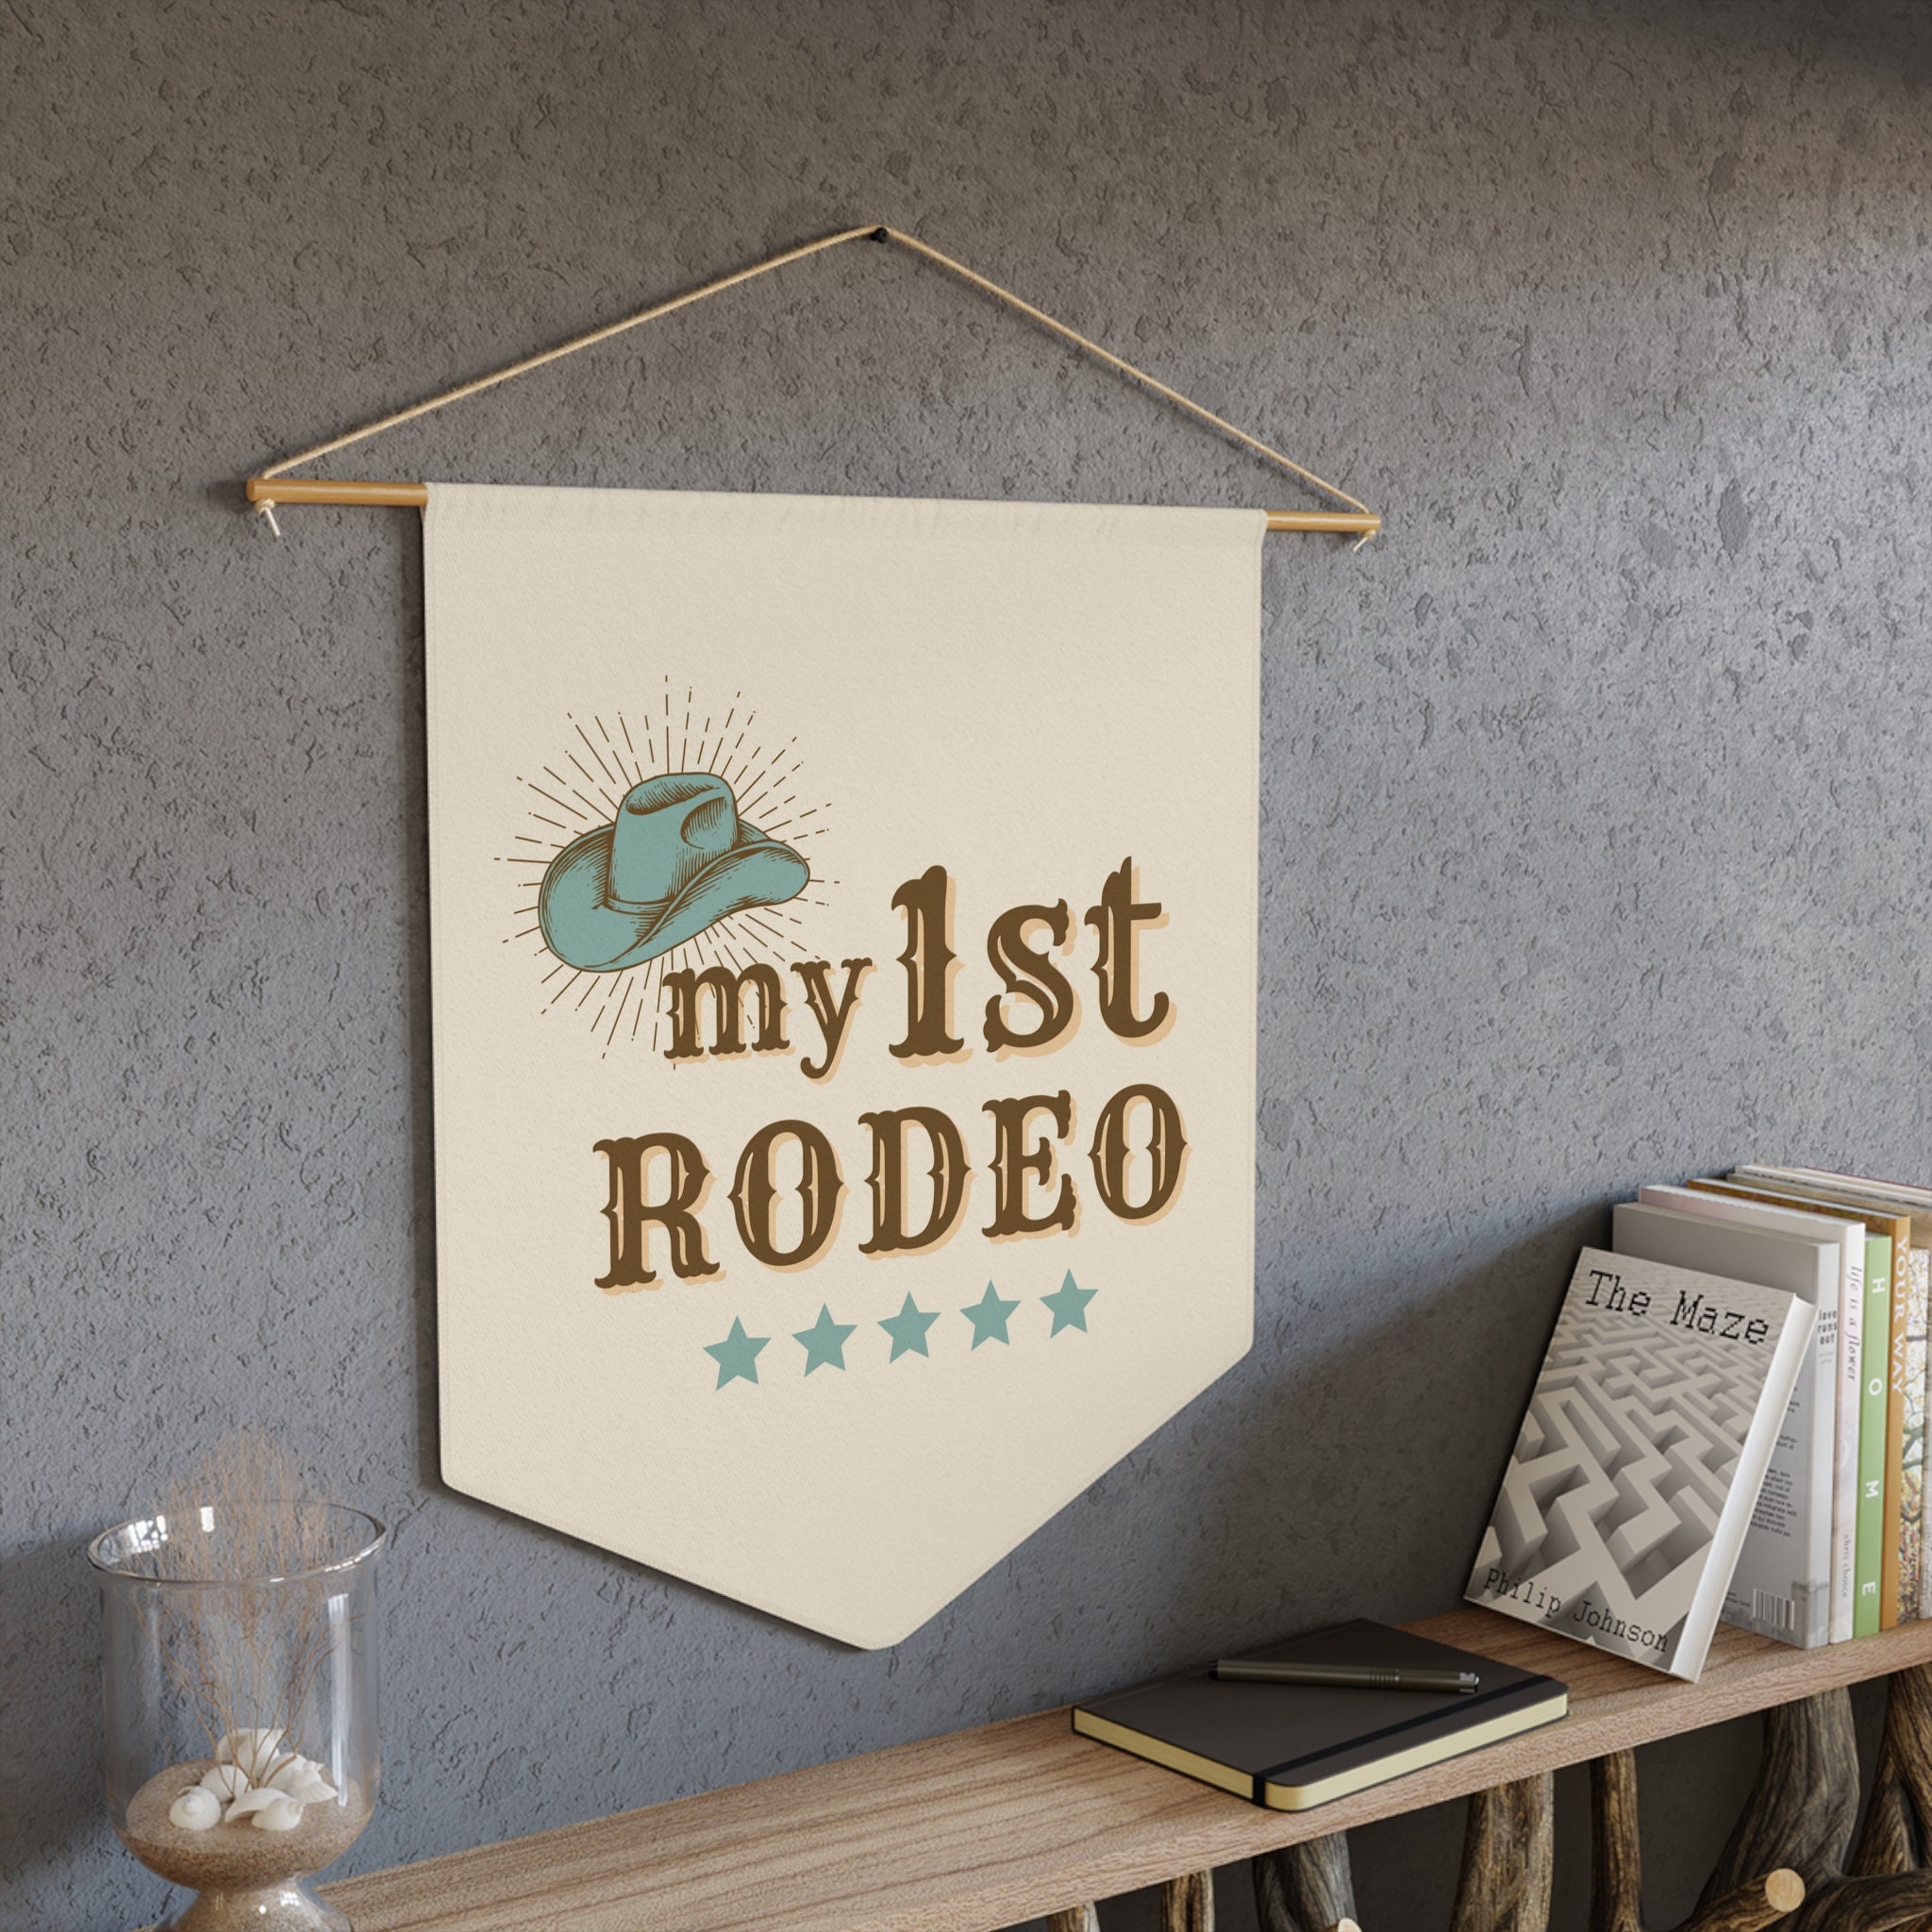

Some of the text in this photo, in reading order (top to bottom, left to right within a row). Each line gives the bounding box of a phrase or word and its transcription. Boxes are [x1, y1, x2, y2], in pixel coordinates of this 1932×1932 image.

[663, 856, 1177, 1085] my 1st
[592, 1083, 1192, 1296] RODEO
[1846, 1266, 1862, 1291] life
[1585, 1270, 1770, 1344] The Maze
[1817, 1322, 1838, 1334] runs
[1818, 1308, 1837, 1322] love
[1849, 1298, 1858, 1310] is
[1891, 1235, 1907, 1394] YOUR WAY
[1820, 1333, 1835, 1345] out
[1844, 1331, 1860, 1381] flower
[1484, 1567, 1669, 1652] Philip Johnson
